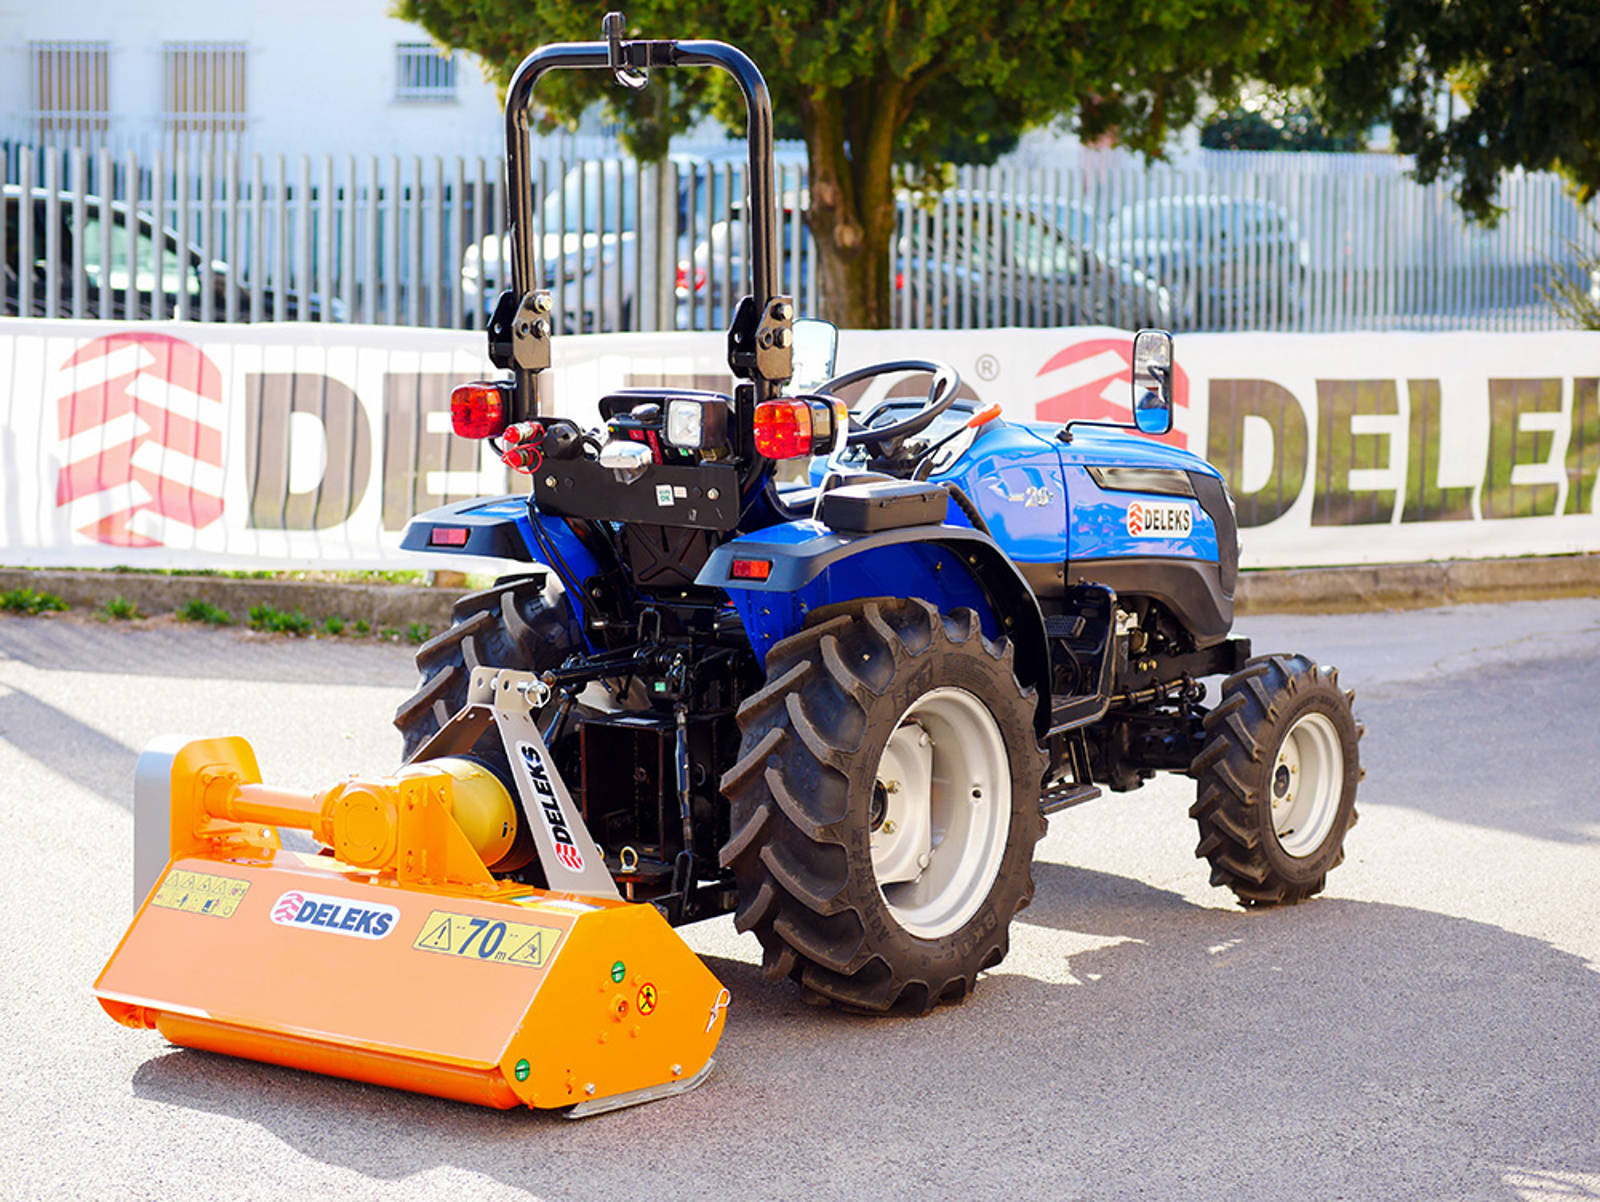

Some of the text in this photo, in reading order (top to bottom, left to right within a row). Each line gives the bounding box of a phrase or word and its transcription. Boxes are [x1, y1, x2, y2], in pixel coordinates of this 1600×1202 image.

[1144, 509, 1190, 532] DELEKS
[521, 745, 574, 846] DELEKS
[294, 900, 393, 936] DELEKS
